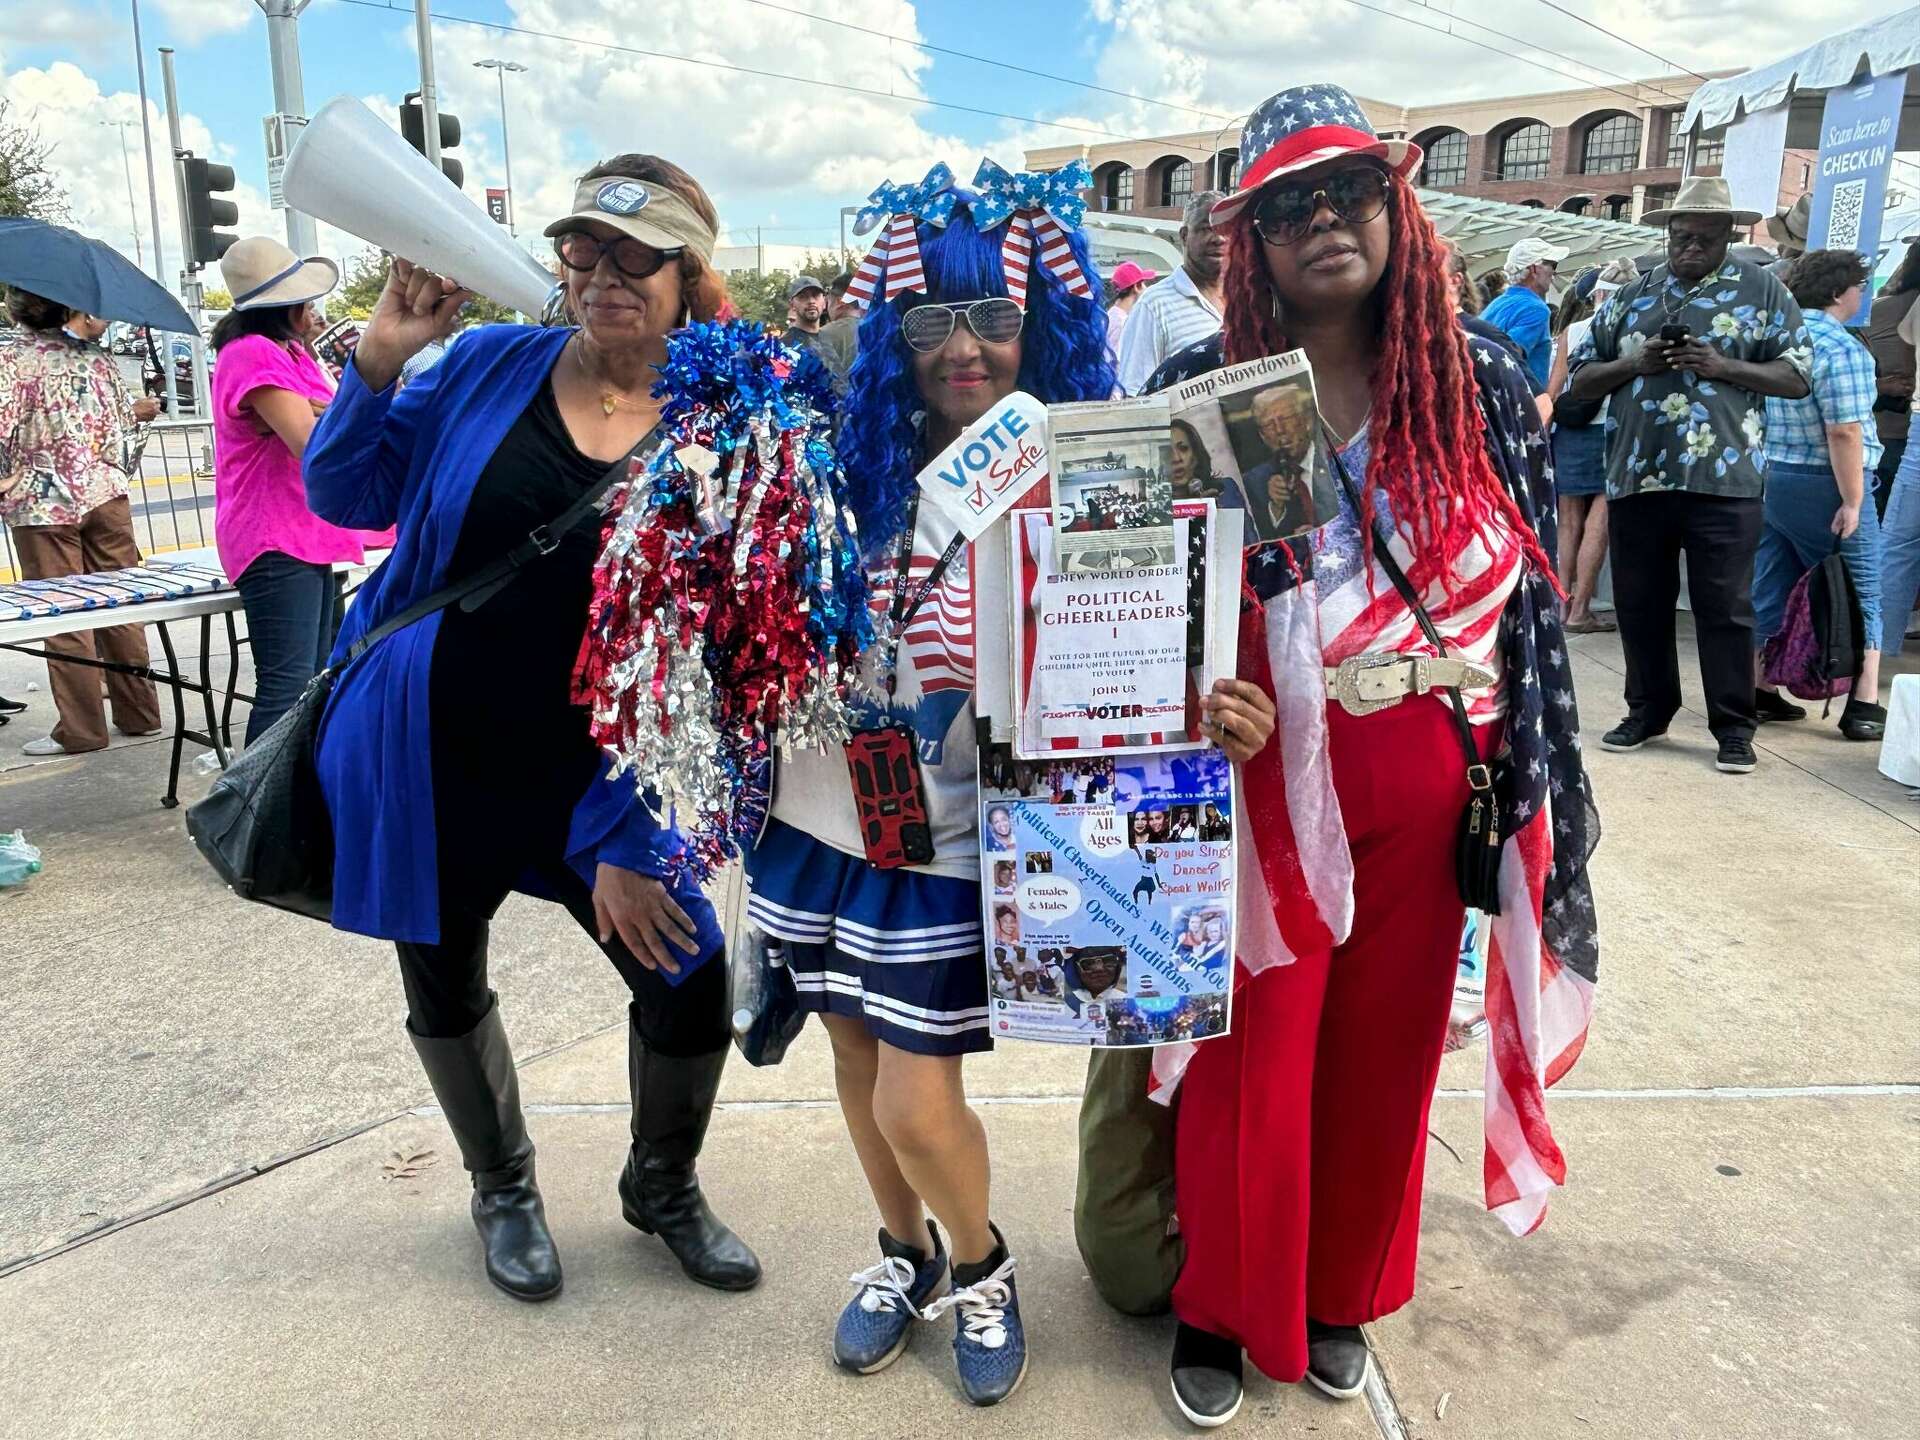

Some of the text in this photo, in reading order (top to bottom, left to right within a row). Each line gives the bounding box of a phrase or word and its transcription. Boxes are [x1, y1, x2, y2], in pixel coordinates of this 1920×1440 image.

[1826, 116, 1891, 148] Scan here to
[1823, 145, 1887, 176] CHECK IN
[1218, 351, 1300, 387] showdown
[937, 408, 1030, 489] VOTE
[989, 438, 1043, 491] Safe
[943, 543, 959, 563] ZIZO
[1060, 566, 1183, 583] NEW WORLD ORDER!
[1066, 589, 1165, 607] POLITICAL
[1043, 604, 1186, 626] CHEERLEADERS
[1038, 662, 1083, 671] CHILDREN
[1114, 659, 1136, 667] THEY
[1092, 684, 1137, 696] JOIN US
[1086, 704, 1144, 720] VOTER
[1094, 817, 1113, 830] All
[1088, 833, 1122, 849] Ages
[1014, 801, 1066, 850] Political
[1063, 846, 1141, 919] Cheerleaders
[1155, 844, 1231, 859] Do you Sing?
[1173, 862, 1220, 876] Dance?
[1027, 887, 1068, 897] Females
[1028, 901, 1067, 911] & Males
[1086, 899, 1194, 994] Open Auditions
